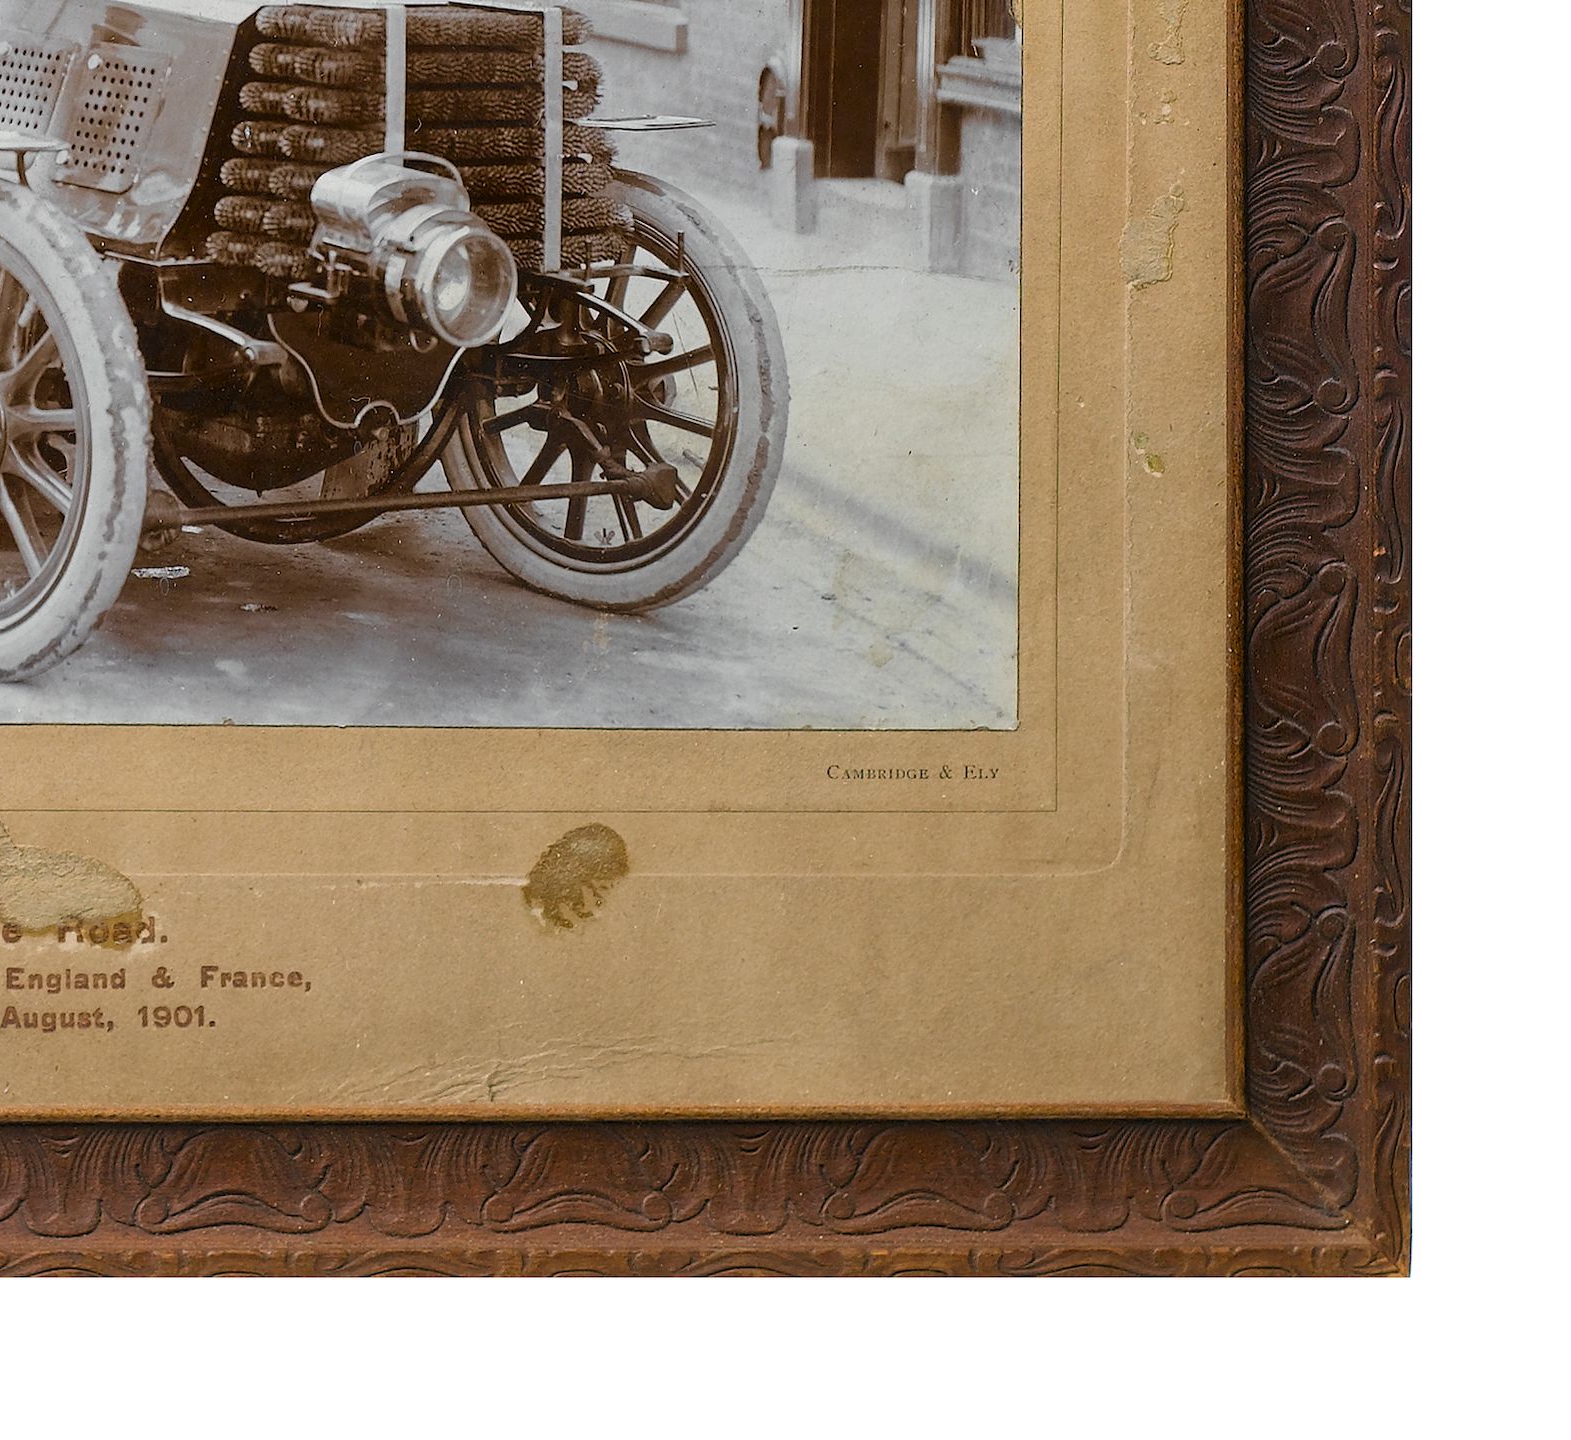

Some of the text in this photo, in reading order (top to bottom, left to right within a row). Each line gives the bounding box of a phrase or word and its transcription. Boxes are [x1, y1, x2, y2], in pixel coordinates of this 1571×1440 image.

[826, 764, 1000, 781] CAMBRIDGE & ELY
[6, 967, 127, 997] England
[150, 967, 175, 990] &
[200, 965, 314, 994] France,
[0, 1006, 116, 1033] August,
[137, 1005, 217, 1030] 1901.
